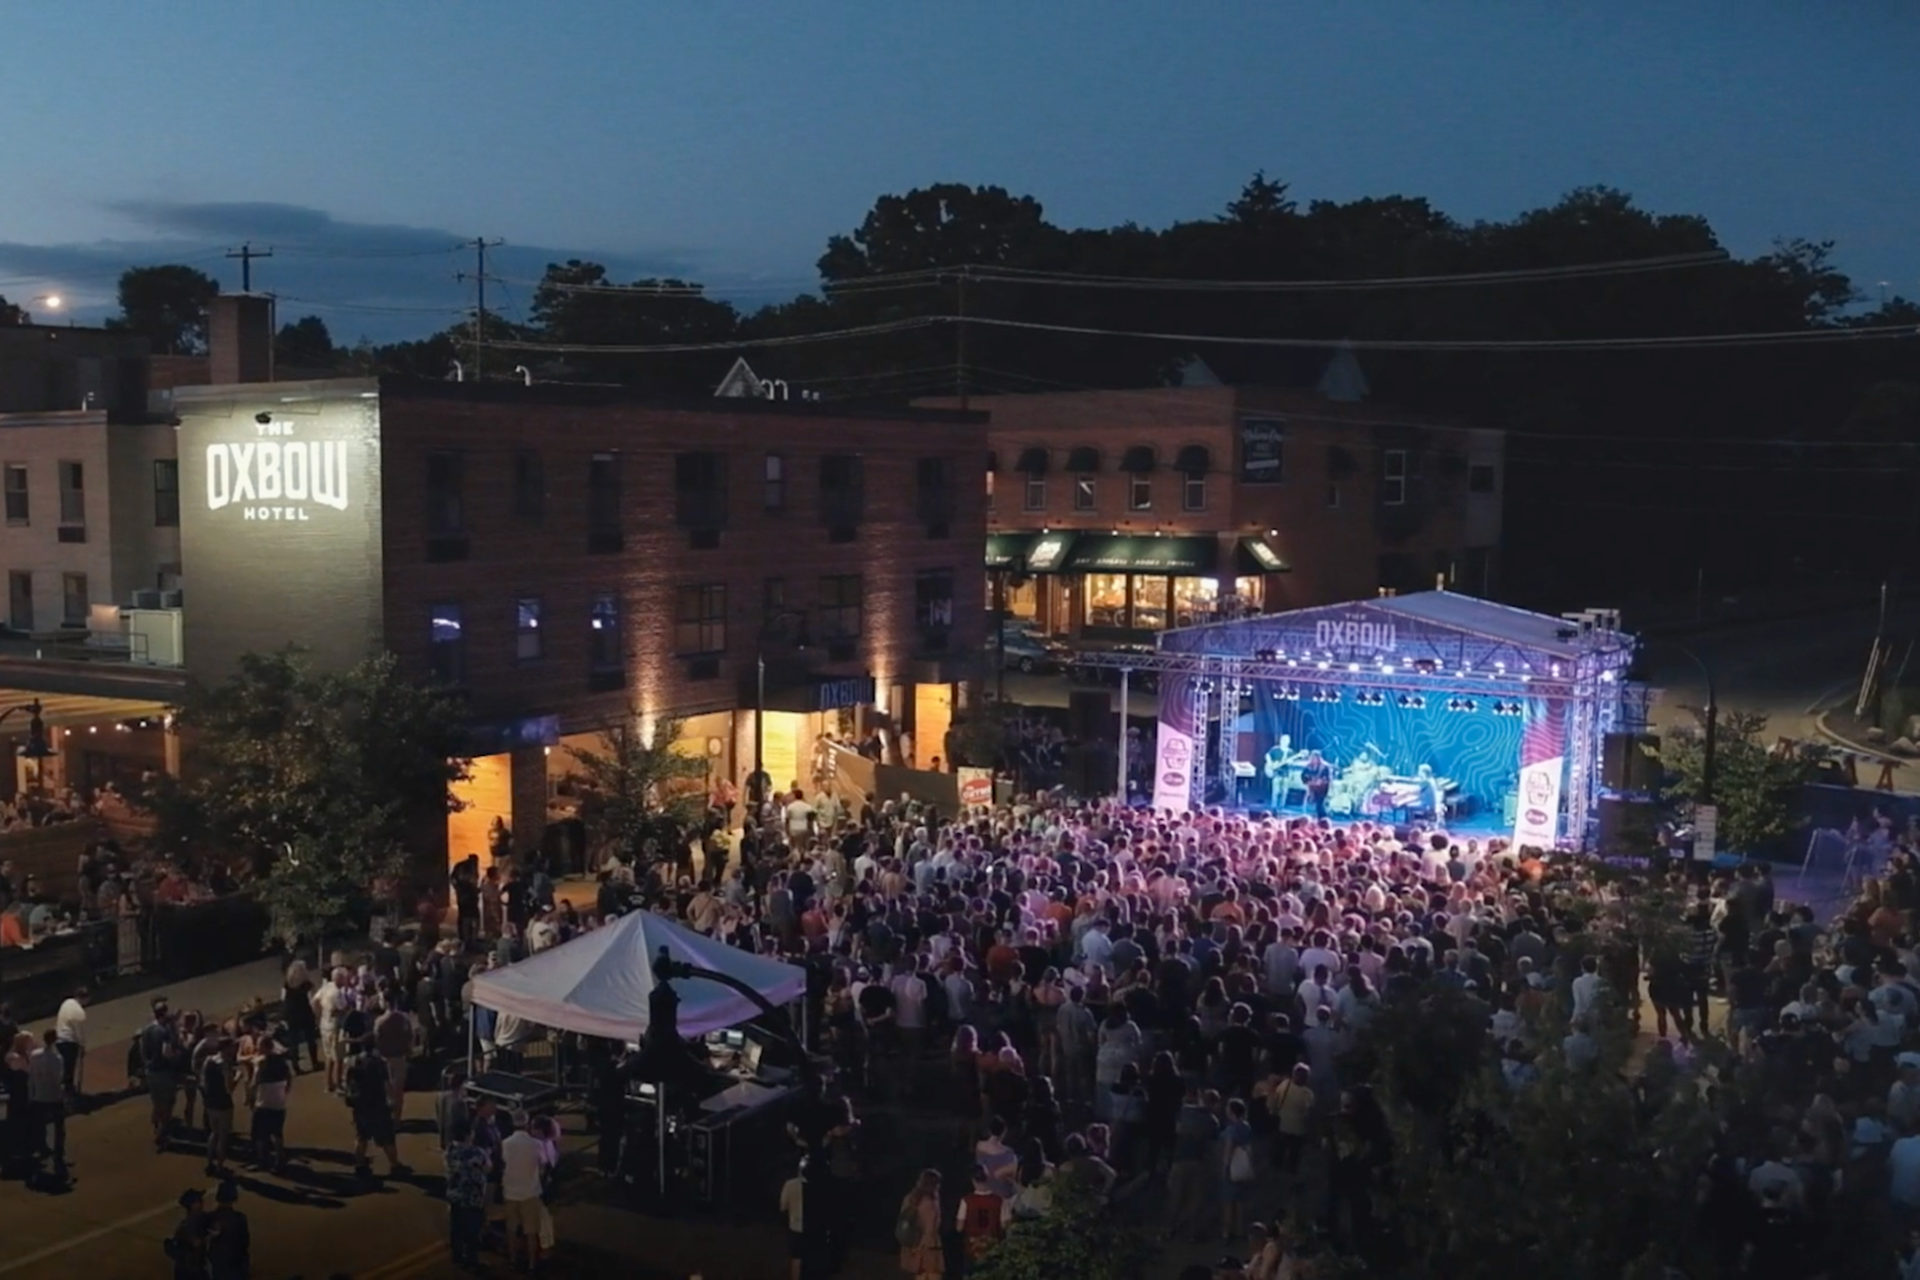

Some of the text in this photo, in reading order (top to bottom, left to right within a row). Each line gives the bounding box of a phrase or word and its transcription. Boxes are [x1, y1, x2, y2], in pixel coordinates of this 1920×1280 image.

[256, 421, 295, 436] THE
[206, 440, 348, 511] OXBOW
[243, 507, 309, 520] HOTEL
[1316, 620, 1396, 652] OXBOW
